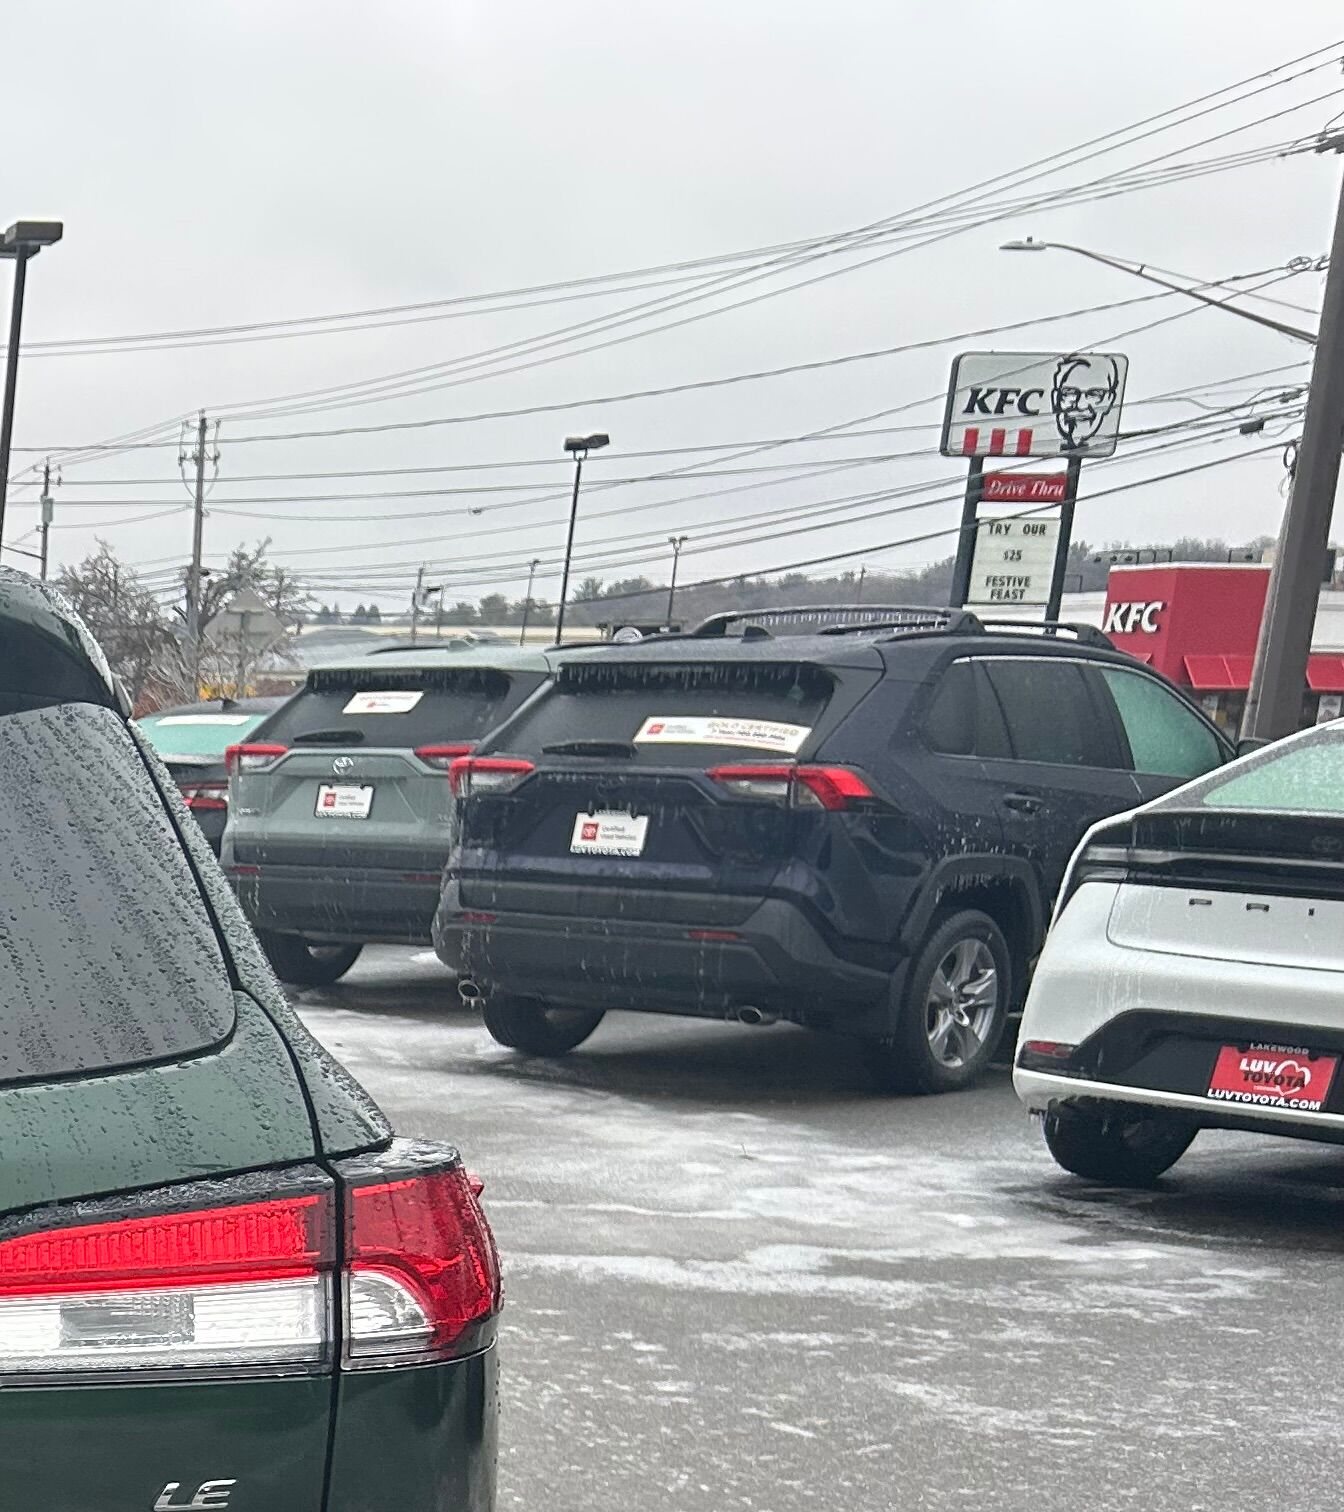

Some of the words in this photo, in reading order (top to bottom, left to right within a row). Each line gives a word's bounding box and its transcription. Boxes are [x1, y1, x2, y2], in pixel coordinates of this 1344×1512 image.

[963, 387, 1044, 415] KFC
[988, 480, 1026, 497] Drive
[1031, 480, 1064, 497] Thru
[988, 522, 1011, 536] TRY
[1023, 523, 1047, 536] OUR
[985, 575, 1032, 588] FESTIVE
[990, 588, 1026, 601] FEAST
[1102, 601, 1164, 633] KFC
[1249, 1042, 1310, 1055] LAKEWOOD
[1240, 1058, 1278, 1073] LUV
[1243, 1072, 1306, 1088] TOYOTA
[1207, 1088, 1322, 1111] LUVTOYOTA.COM
[153, 1479, 237, 1512] LE
